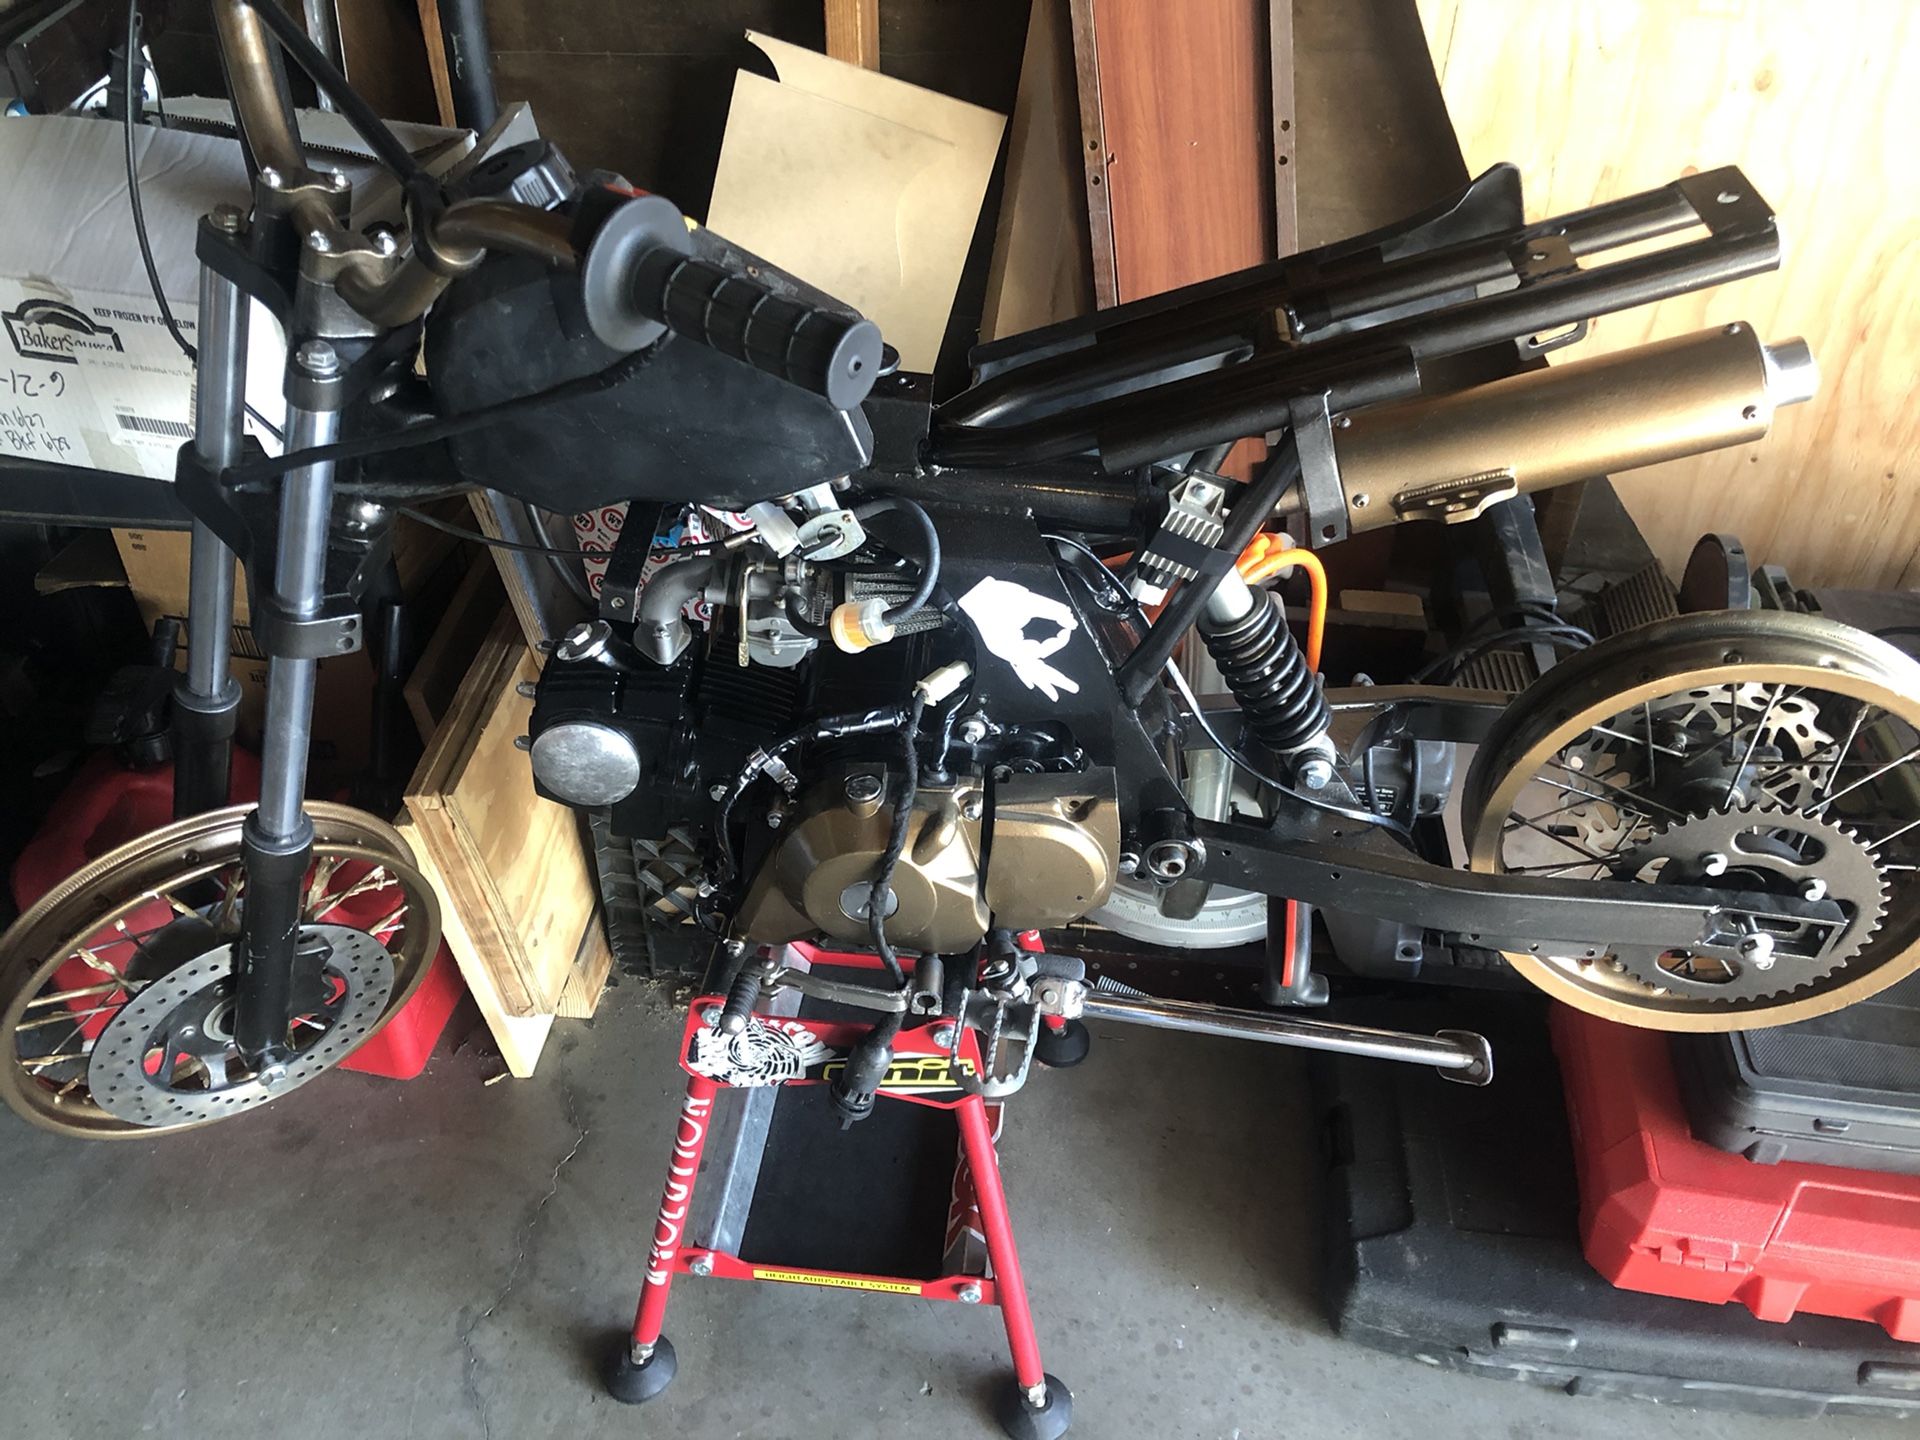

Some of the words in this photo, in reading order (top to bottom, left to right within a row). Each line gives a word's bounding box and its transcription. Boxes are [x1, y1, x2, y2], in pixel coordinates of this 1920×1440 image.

[93, 308, 112, 318] KEEP
[113, 311, 142, 323] FROZEN
[172, 318, 196, 330] ELOW
